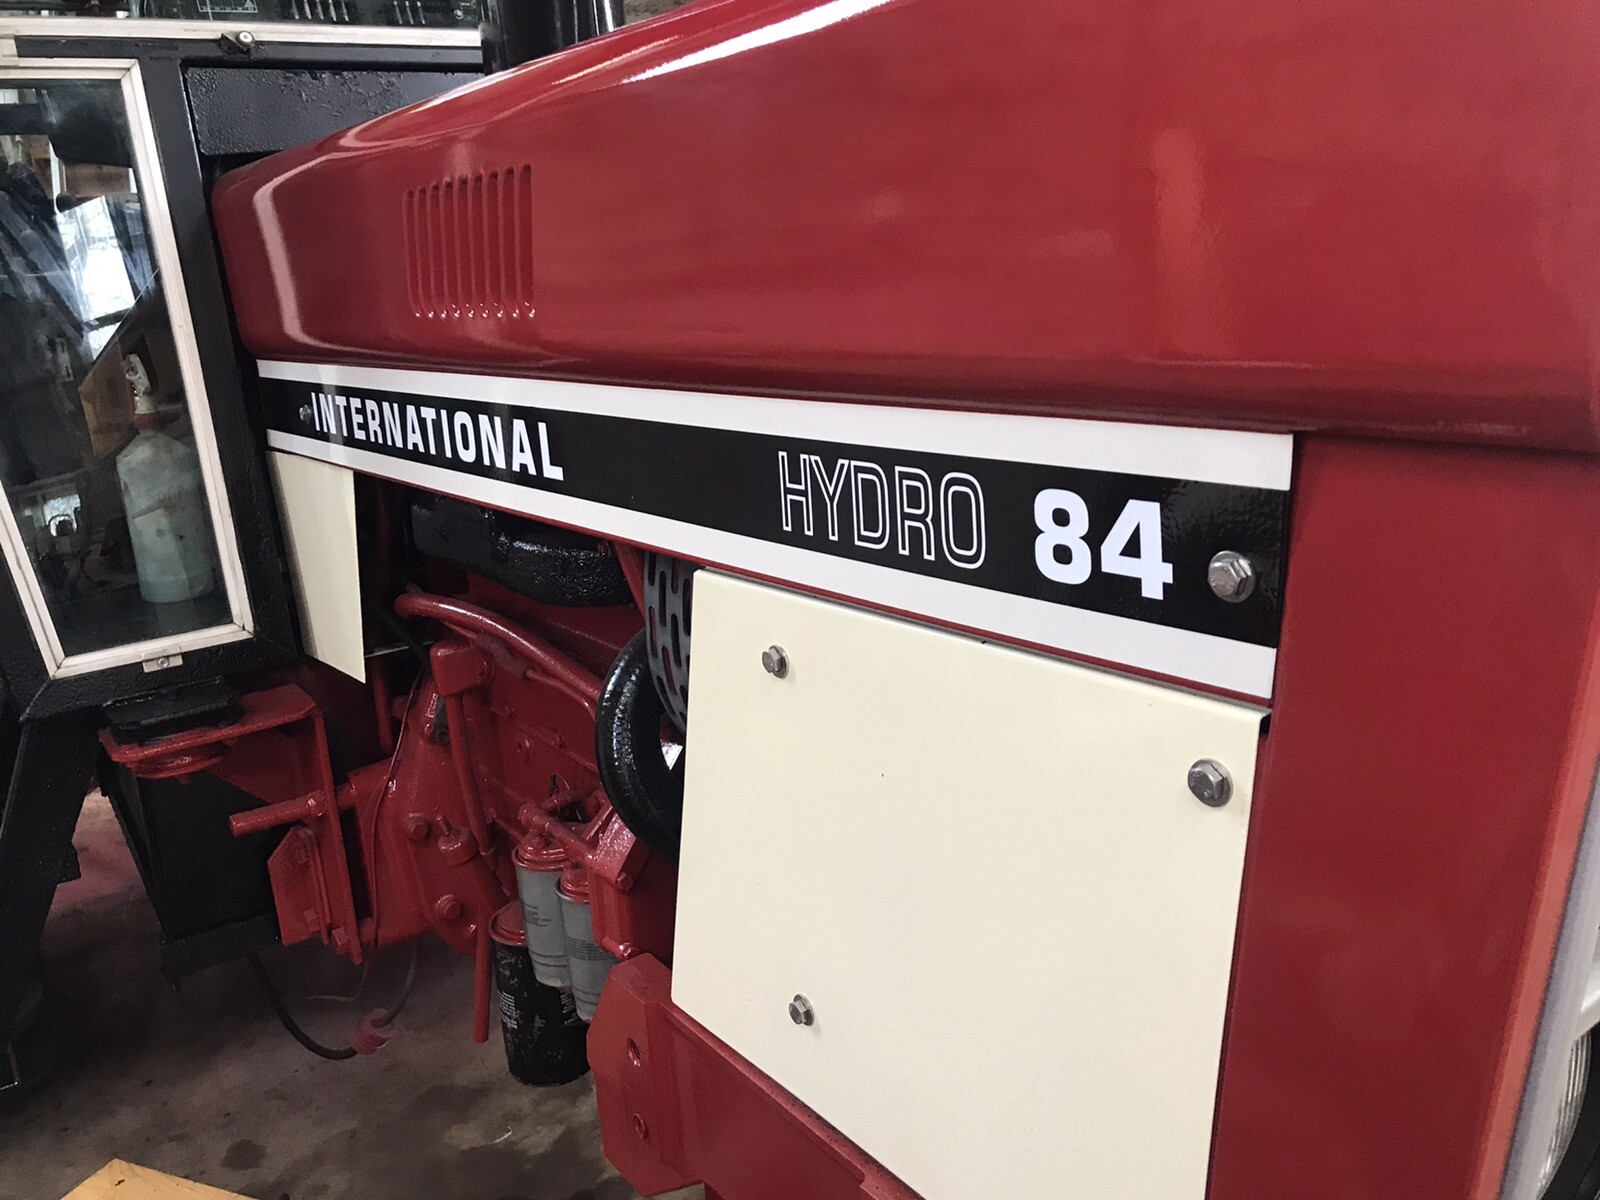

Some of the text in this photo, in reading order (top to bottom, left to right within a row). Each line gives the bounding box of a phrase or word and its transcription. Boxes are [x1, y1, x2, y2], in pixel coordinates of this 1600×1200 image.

[310, 391, 564, 481] INTERNATIONAL
[778, 450, 1174, 601] HYDRO 84
